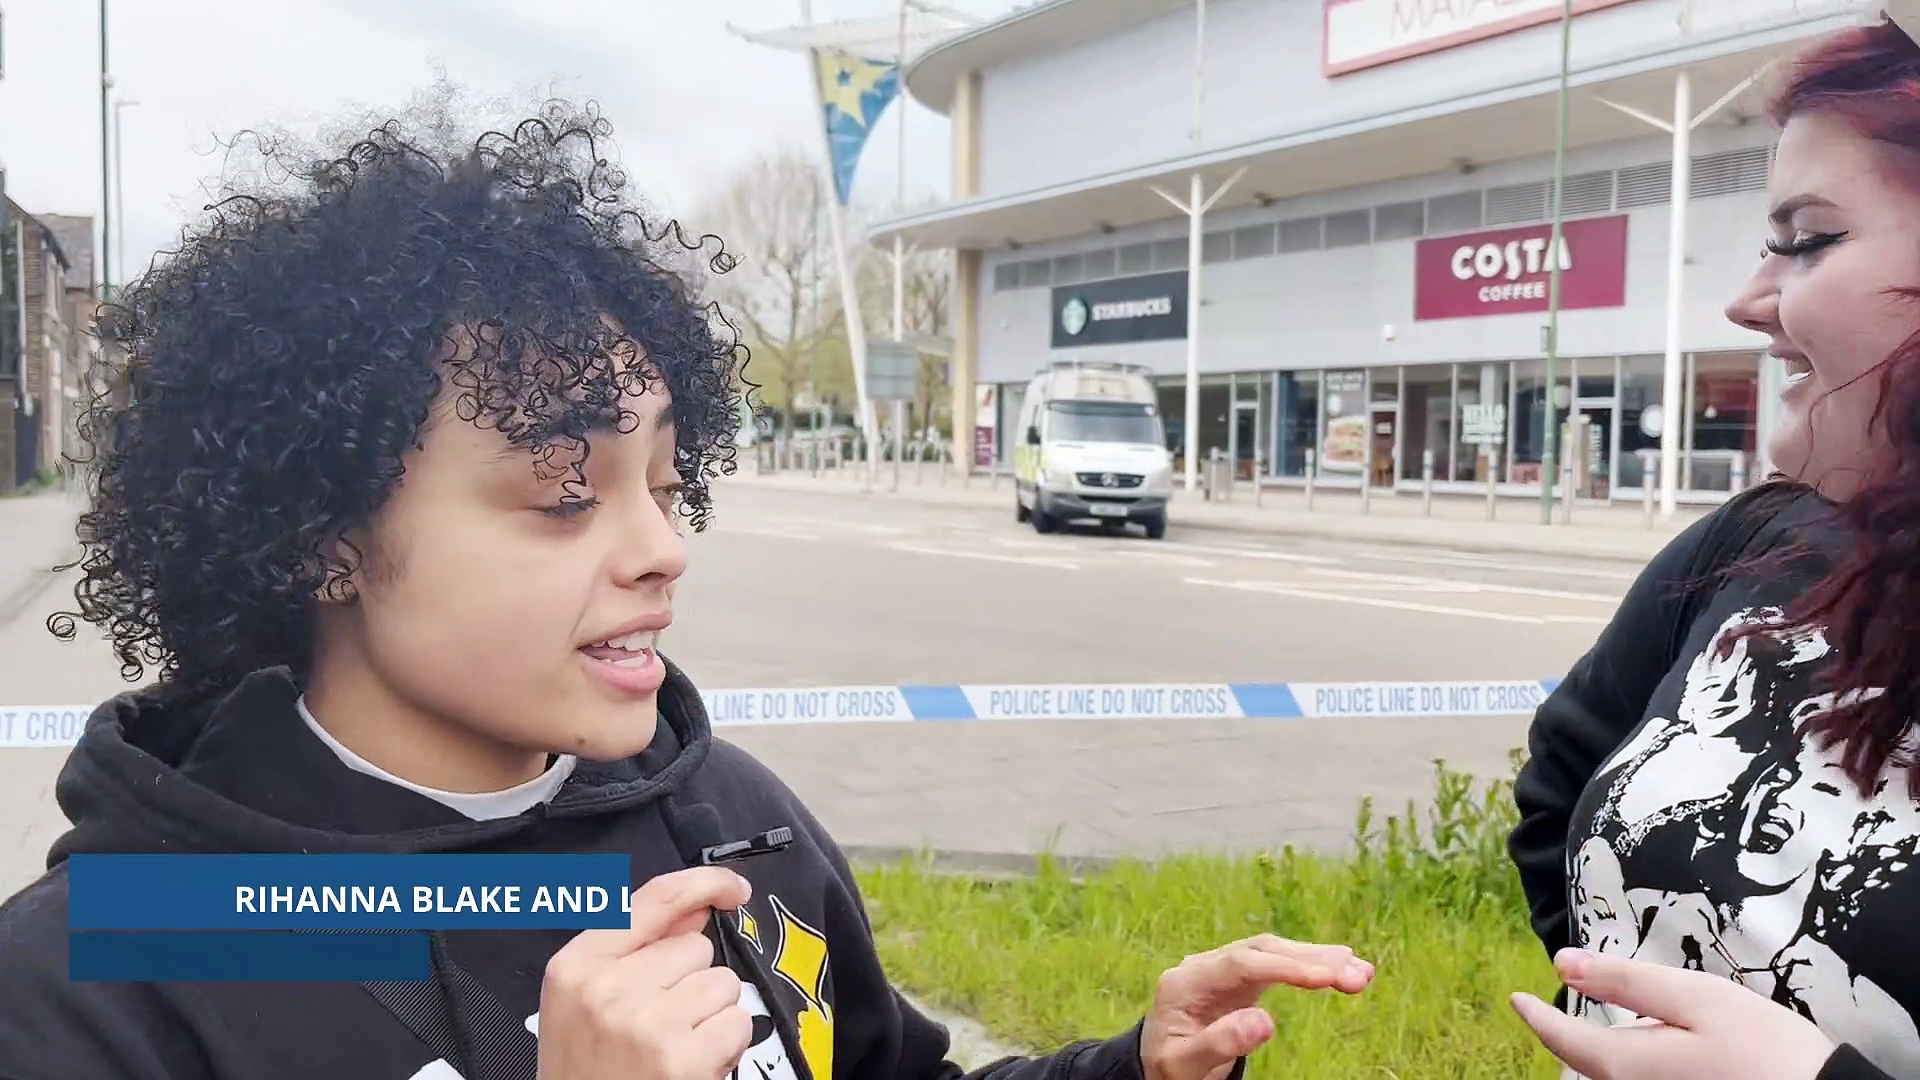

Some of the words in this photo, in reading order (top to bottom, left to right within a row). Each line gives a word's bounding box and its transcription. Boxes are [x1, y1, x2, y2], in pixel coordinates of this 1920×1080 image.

[1451, 238, 1573, 280] COSTA
[1478, 281, 1545, 302] COFFEE
[1092, 297, 1172, 321] STARBUCKS
[713, 693, 755, 721] LINE
[762, 693, 787, 719] DO
[794, 691, 829, 718] NOT
[836, 690, 896, 717] CROSS
[990, 689, 1051, 715] POLICE
[1057, 689, 1095, 714] LINE
[1102, 689, 1124, 714] DO
[1131, 688, 1164, 714] NOT
[1171, 688, 1227, 714] CROSS
[1316, 687, 1373, 713] POLICE
[1379, 687, 1415, 712] LINE
[1421, 686, 1442, 711] DO
[1449, 685, 1480, 711] NOT
[1486, 685, 1538, 710] CROSS
